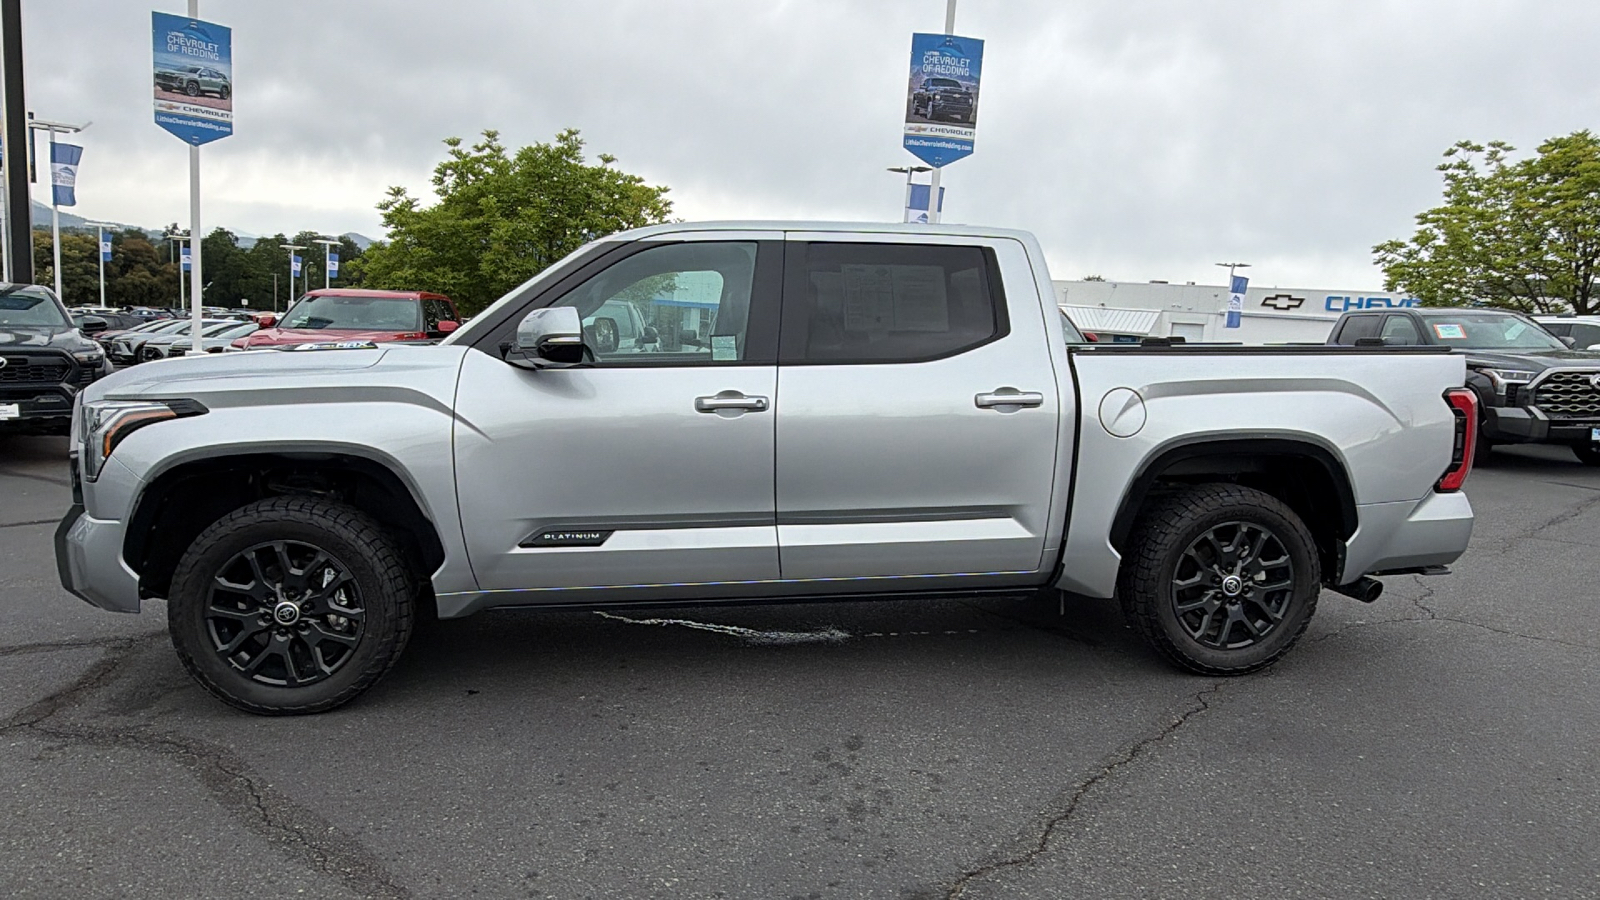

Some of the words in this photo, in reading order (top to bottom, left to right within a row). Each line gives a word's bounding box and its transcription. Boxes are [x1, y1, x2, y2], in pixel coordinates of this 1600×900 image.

[167, 35, 219, 53] CHEVROLET
[167, 43, 179, 53] OF
[181, 46, 219, 61] REDDING
[923, 55, 971, 68] CHEVROLET
[922, 63, 934, 73] OF
[935, 65, 970, 77] REDDING
[182, 106, 230, 119] CHEVROLET
[929, 127, 973, 137] CHEVROLET
